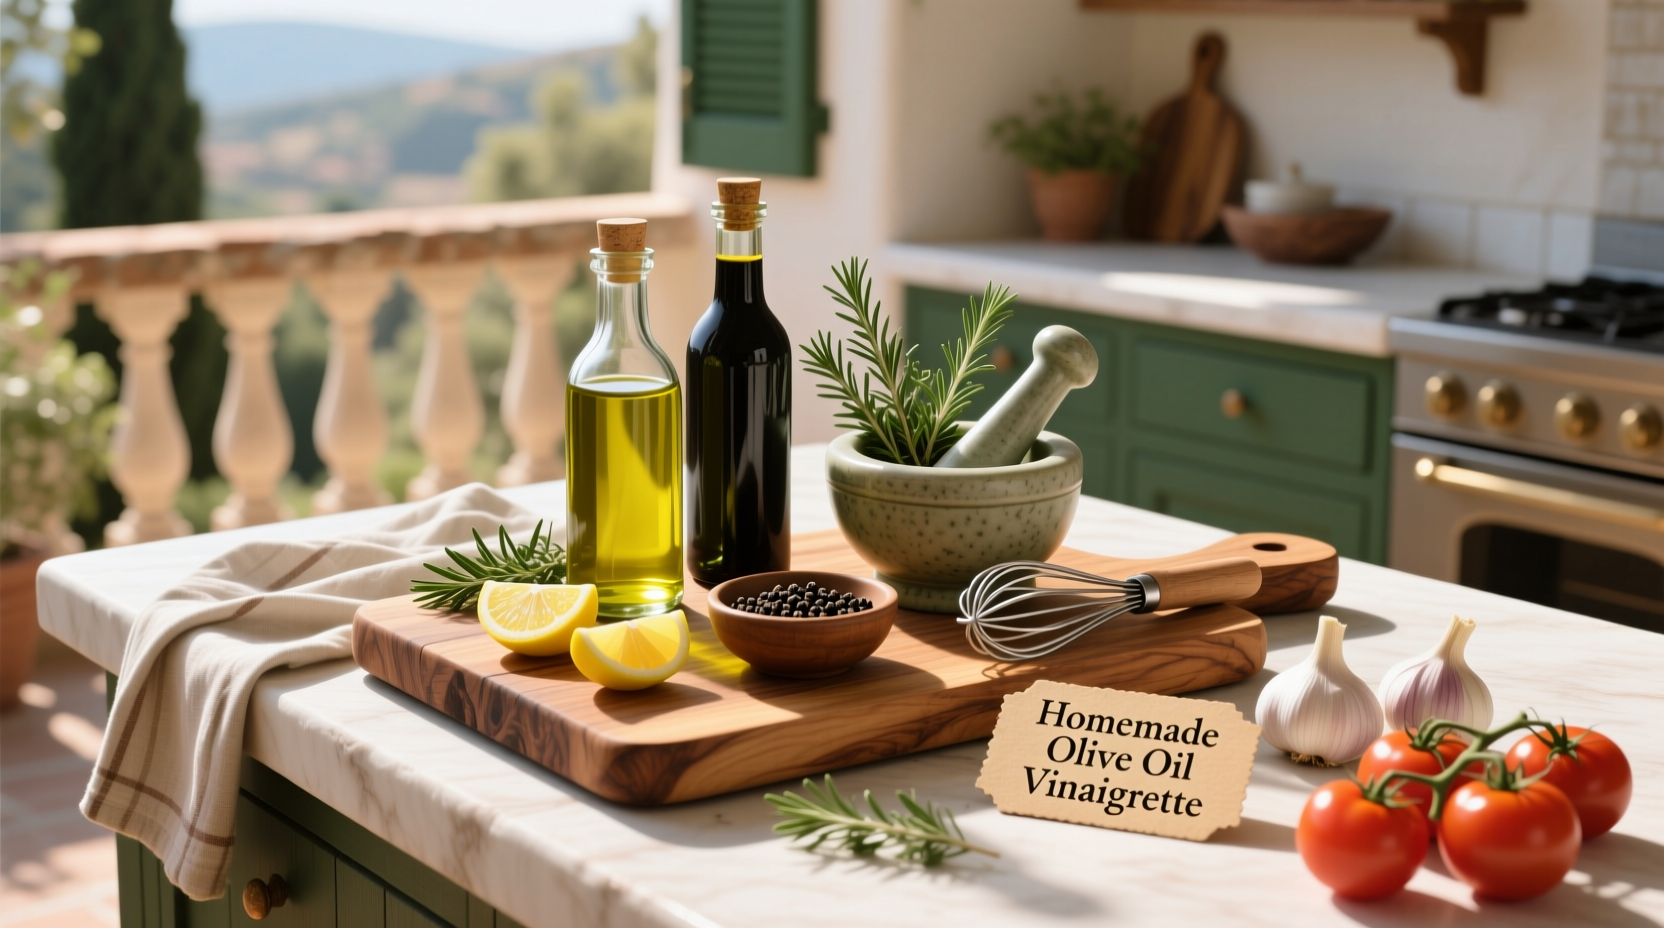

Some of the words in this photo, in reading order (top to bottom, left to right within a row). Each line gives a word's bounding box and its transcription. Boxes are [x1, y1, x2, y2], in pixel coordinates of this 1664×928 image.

[1036, 698, 1219, 748] Homemade
[1046, 735, 1133, 772] Olive
[1142, 748, 1195, 781] Oil
[1023, 765, 1203, 817] Vinaigrette
